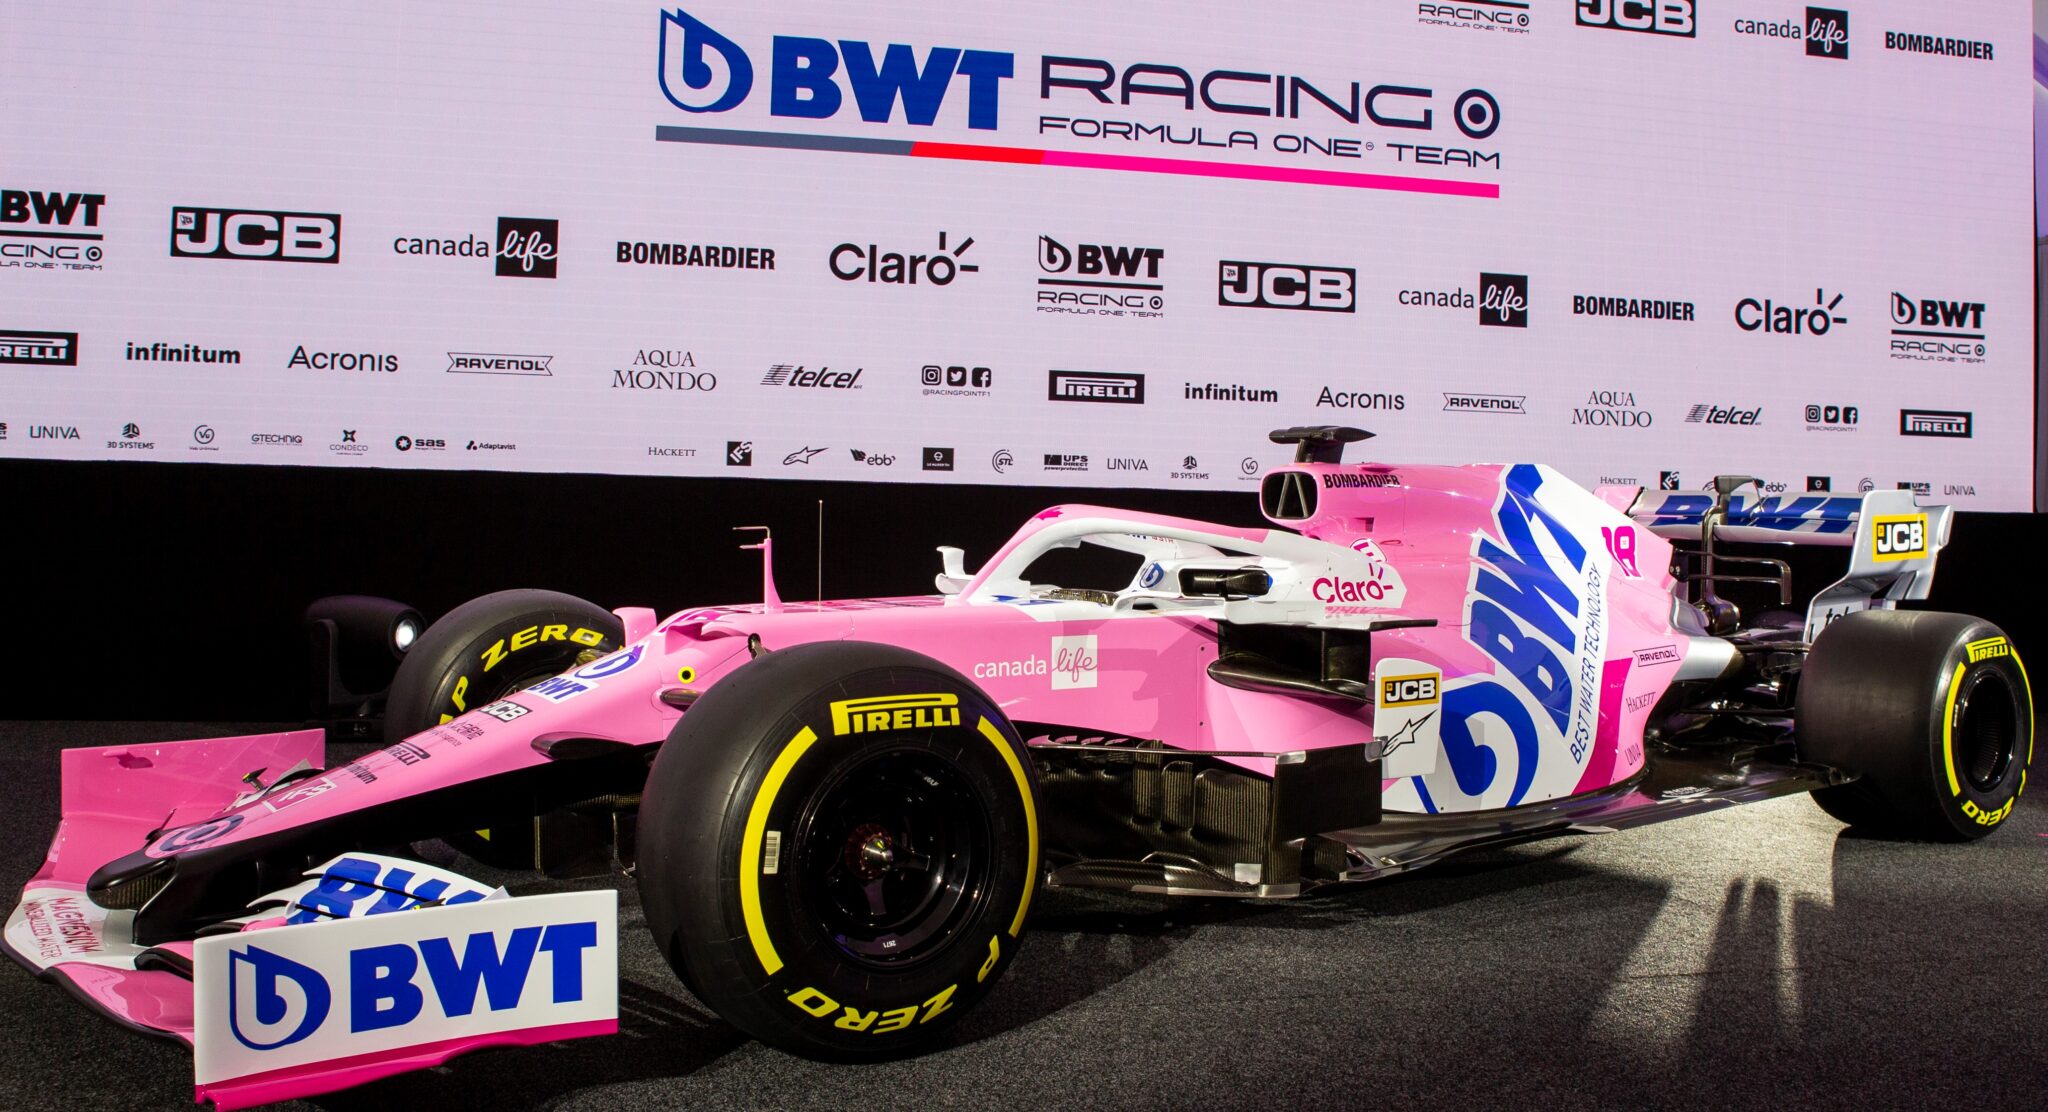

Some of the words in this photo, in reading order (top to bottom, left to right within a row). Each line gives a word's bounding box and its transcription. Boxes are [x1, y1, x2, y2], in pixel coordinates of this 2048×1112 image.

[1418, 17, 1471, 28] FORMULA
[1419, 3, 1512, 24] RACING
[1579, 0, 1693, 34] JCB
[1734, 19, 1801, 39] canada
[1805, 18, 1848, 53] life
[1885, 31, 1994, 60] BOMBARDIER
[770, 35, 1015, 131] BWT
[1040, 55, 1432, 131] RACING
[1039, 116, 1258, 150] FORMULA
[1386, 143, 1500, 170] TEAM
[0, 190, 106, 227] BWT
[176, 212, 337, 259] JCB
[394, 234, 490, 257] canada
[496, 230, 558, 272] life
[616, 241, 775, 270] BOMBARDIER
[1077, 244, 1164, 278] BWT
[63, 263, 103, 271] TEAM
[829, 242, 956, 286] Claro
[1037, 290, 1145, 308] RACING
[1222, 265, 1352, 309] JCB
[1037, 305, 1096, 315] FORMULA
[1398, 288, 1475, 309] canada
[1479, 284, 1528, 322] life
[1573, 296, 1694, 322] BOMBARDIER
[1920, 299, 1985, 329] BWT
[1735, 297, 1830, 336] Claro
[126, 342, 241, 364] infinitum
[287, 345, 399, 372] Acronis
[632, 348, 695, 369] AQUA
[1890, 340, 1971, 355] RACING
[1890, 353, 1935, 361] FORMULA
[455, 357, 545, 371] RAVENOL
[611, 369, 717, 391] MONDO
[787, 365, 863, 389] telcel
[1056, 375, 1137, 399] PIRELLI
[922, 388, 991, 397] @RACINGPOINTF1
[1184, 382, 1278, 402] infinitum
[1316, 386, 1405, 411] Acronis
[1449, 396, 1521, 410] RAVENOL
[1587, 390, 1636, 408] AQUA
[1571, 408, 1653, 427] MONDO
[1705, 405, 1762, 426] telcel
[1905, 414, 1967, 434] PIRELLI
[30, 425, 80, 440] UNIVA
[251, 433, 303, 444] GTECHNIQ
[107, 441, 117, 449] 3D
[119, 442, 155, 450] SYSTEMS
[329, 444, 369, 452] CONDECO
[479, 442, 516, 450] Adaptavist
[1106, 458, 1149, 470] UNIVA
[1180, 472, 1210, 480] SYSTEMS
[1322, 473, 1401, 489] BOMBARDIER
[1943, 485, 1976, 496] UNIVA
[1876, 522, 1924, 554] JCB
[1312, 576, 1384, 604] Claro
[1469, 463, 1588, 738] BWT
[1583, 561, 1601, 660] TECHNOLOGY
[481, 623, 604, 673] ZERO
[1638, 648, 1676, 663] RAVENOL
[1965, 636, 2009, 664] PIRELLI
[974, 655, 1048, 680] canada
[1052, 647, 1098, 684] life
[1385, 680, 1437, 702] JCB
[1579, 656, 1596, 716] WATER
[829, 692, 961, 737] PIRELLI
[1569, 710, 1591, 765] BEST
[1961, 796, 2015, 826] ZERO
[47, 897, 105, 955] MAGNESIUM
[37, 936, 63, 961] WATER
[977, 934, 1001, 984] P
[350, 921, 598, 1035] BWT
[787, 983, 959, 1035] ZERO
